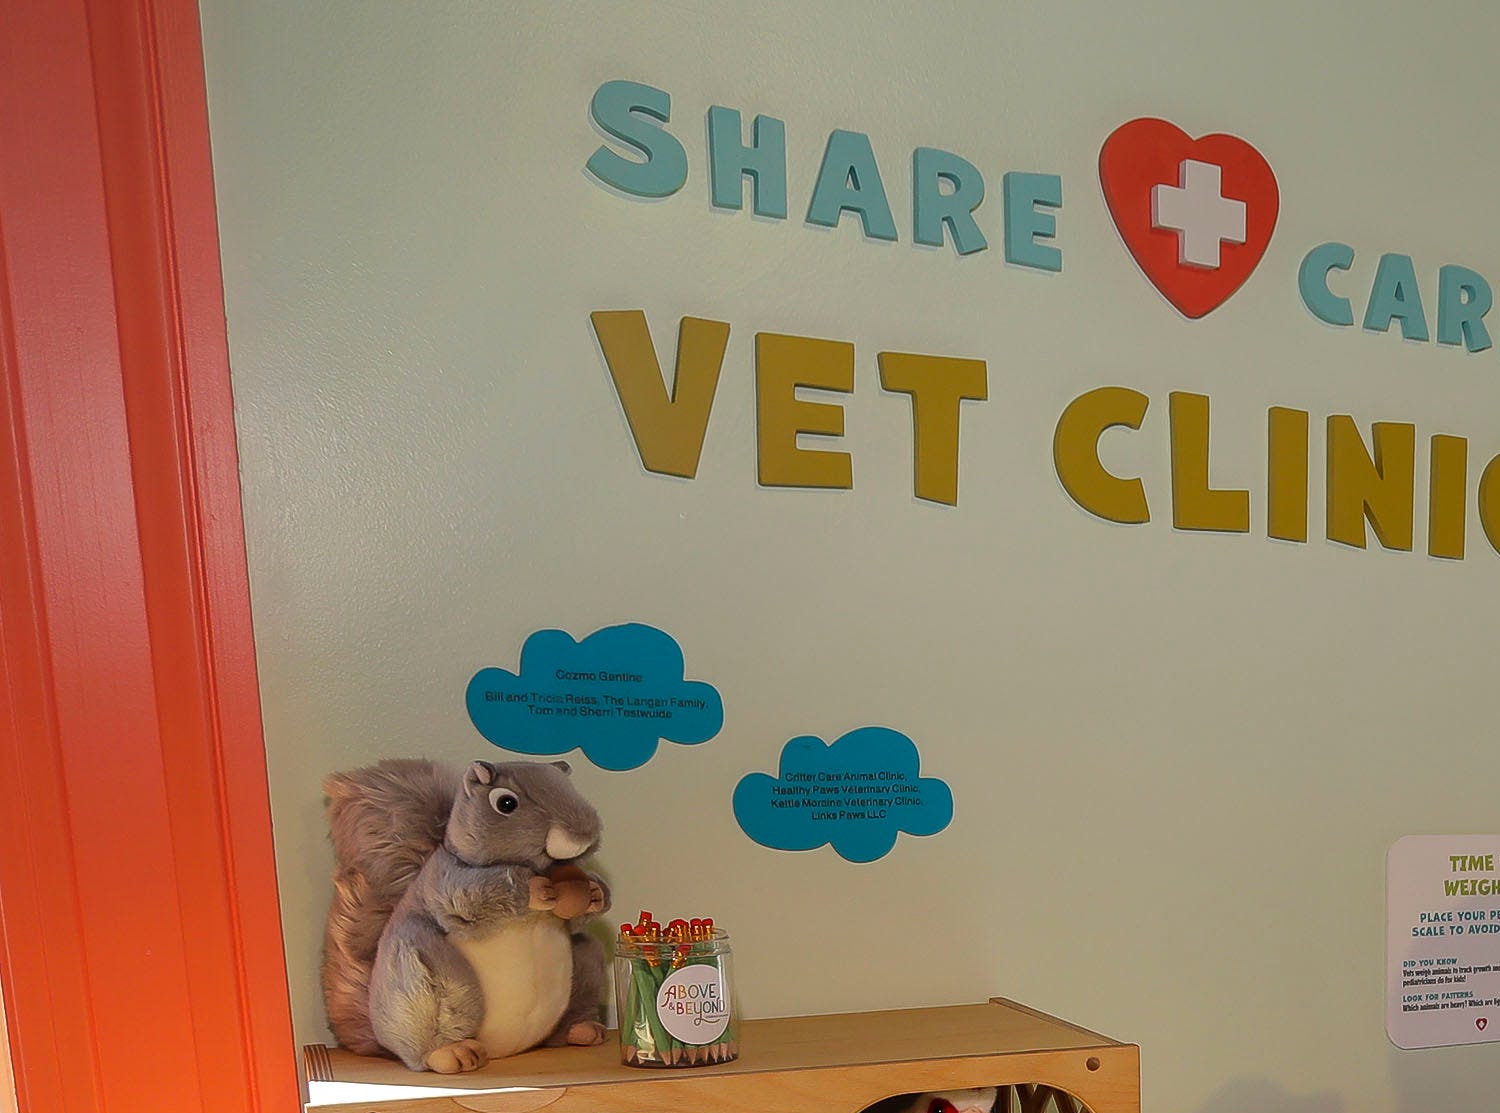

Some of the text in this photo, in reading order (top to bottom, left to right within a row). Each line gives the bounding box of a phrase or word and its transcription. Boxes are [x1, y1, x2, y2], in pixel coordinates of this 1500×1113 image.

[585, 80, 1062, 272] SHARE
[590, 308, 988, 506] VET
[485, 691, 504, 702] Bill
[506, 692, 528, 703] and
[603, 695, 625, 706] The
[528, 704, 554, 715] Tom
[556, 705, 577, 716] and
[817, 772, 843, 782] Care
[844, 772, 877, 782] Animal
[772, 786, 811, 797] Healthy
[812, 785, 839, 795] Paws
[839, 810, 866, 820] Paws
[867, 809, 887, 819] LLC
[1449, 855, 1494, 872] TIME
[1444, 879, 1500, 896] WEIGH
[1420, 912, 1453, 923] PLACE
[1457, 911, 1486, 922] YOUR
[1412, 926, 1445, 937] SCALE
[1449, 925, 1464, 935] TO
[1468, 924, 1500, 935] AVOID
[1403, 958, 1458, 968] DID YOU KNOW
[661, 983, 718, 1008] ABOVE
[1402, 991, 1474, 1003] LOOK FOR PATTERNS
